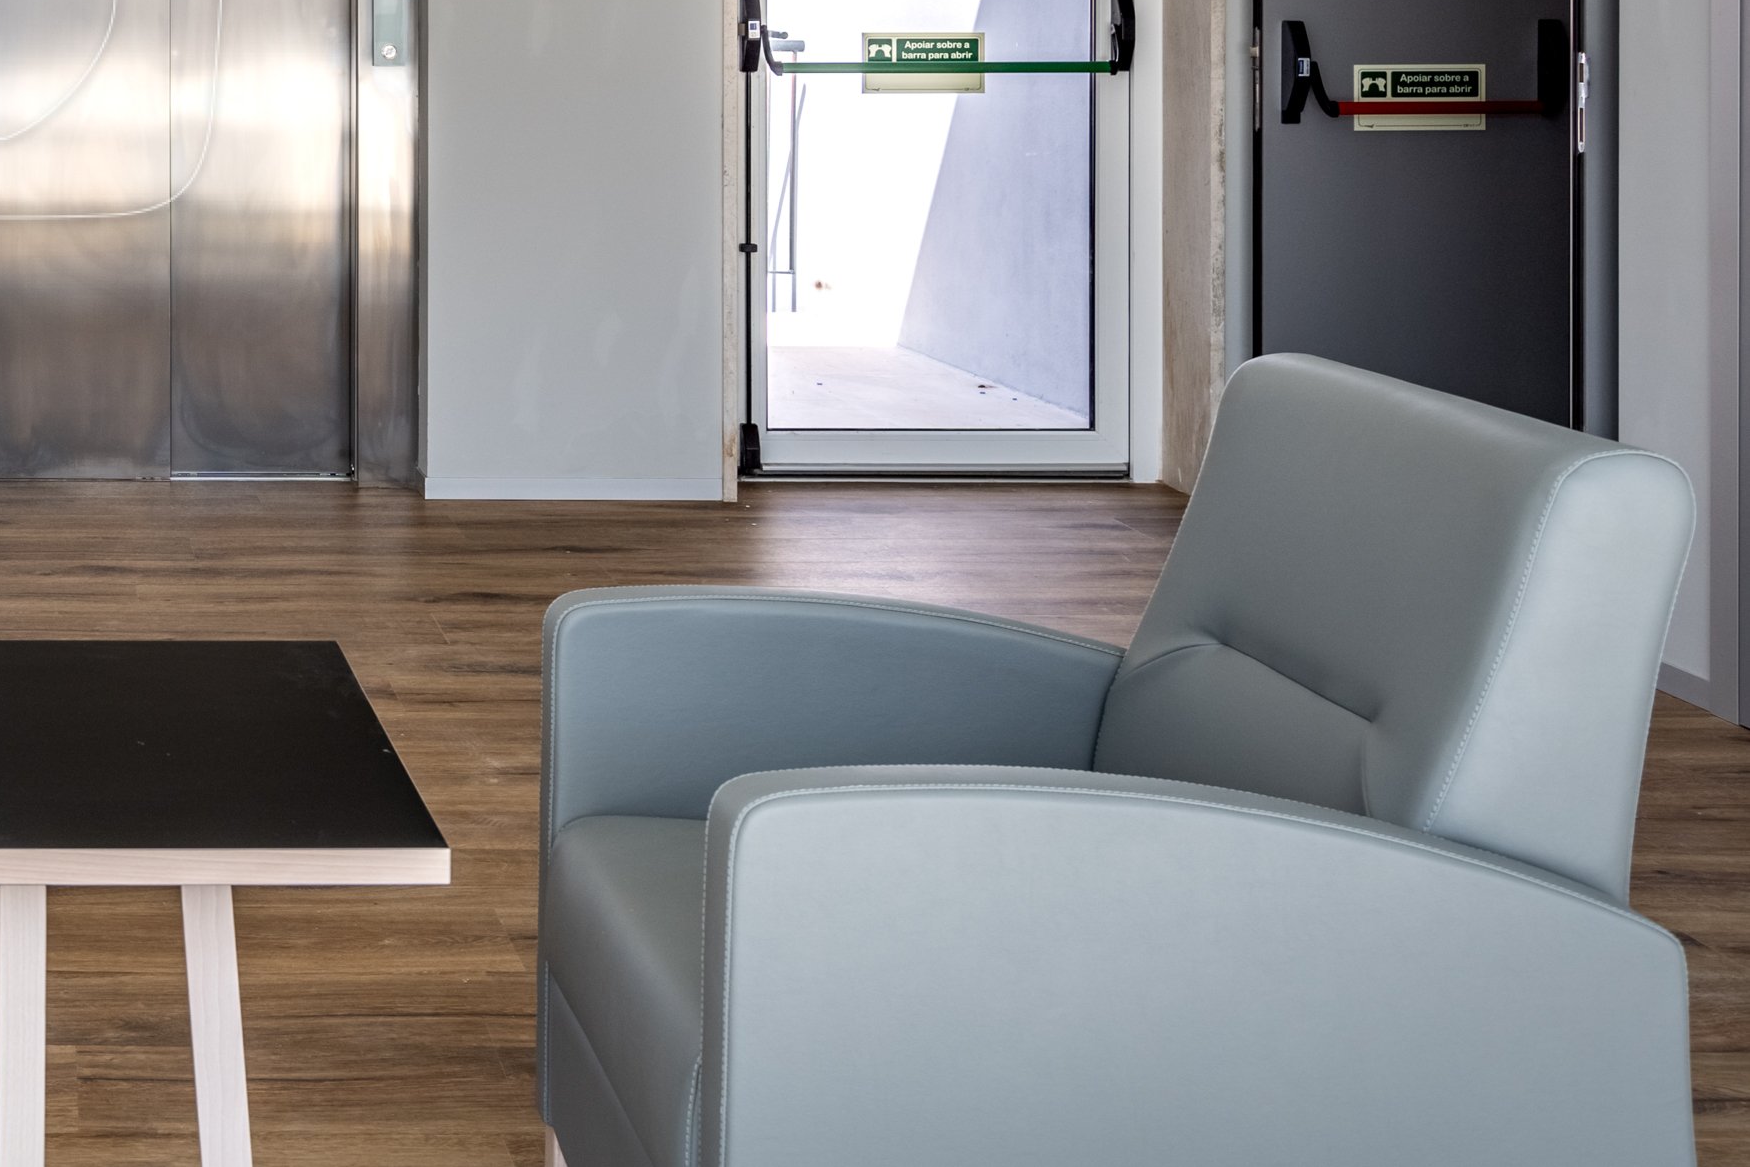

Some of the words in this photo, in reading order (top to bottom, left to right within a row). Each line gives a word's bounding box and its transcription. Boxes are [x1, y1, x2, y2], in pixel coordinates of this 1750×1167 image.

[904, 41, 934, 50] Apoiar
[936, 41, 962, 49] sobre
[902, 51, 926, 59] barra
[951, 51, 973, 59] abrir
[1400, 74, 1431, 83] Apoiar
[1434, 74, 1461, 82] sobre
[1397, 85, 1423, 93] barra
[1425, 86, 1447, 95] para
[1449, 85, 1472, 93] abrir
